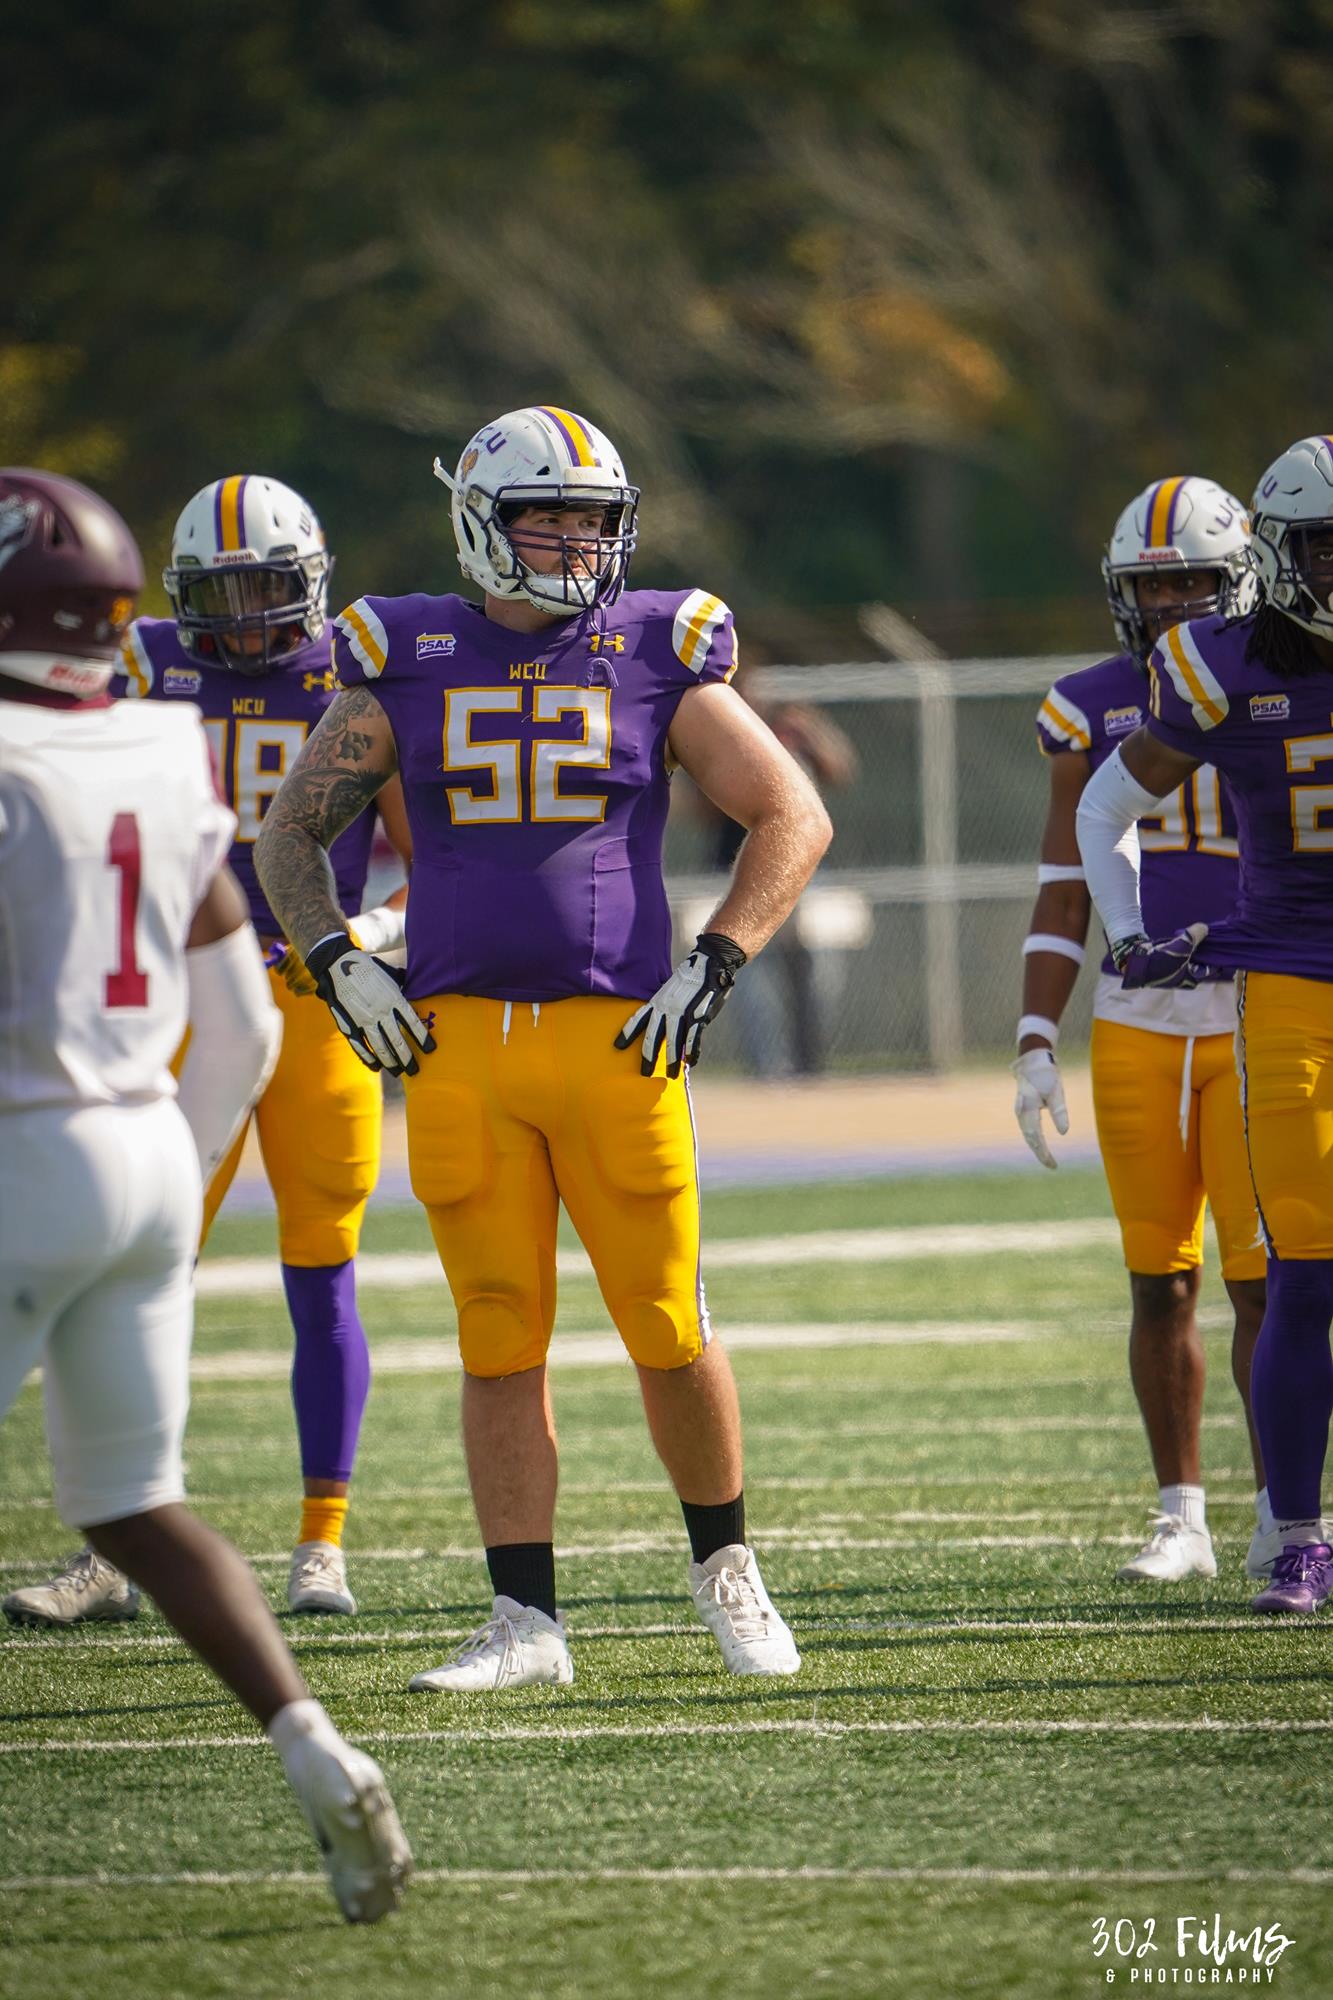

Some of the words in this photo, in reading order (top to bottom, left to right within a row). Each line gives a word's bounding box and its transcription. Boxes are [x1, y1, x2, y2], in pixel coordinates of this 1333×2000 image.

[212, 552, 252, 565] Riddell
[418, 639, 453, 654] PSAC
[509, 663, 546, 680] WCU
[165, 675, 198, 690] PSAC
[232, 698, 266, 716] WCU
[1252, 700, 1287, 714] PSAC
[1107, 713, 1139, 728] PSAC
[443, 685, 612, 825] 52
[105, 813, 148, 1008] 1
